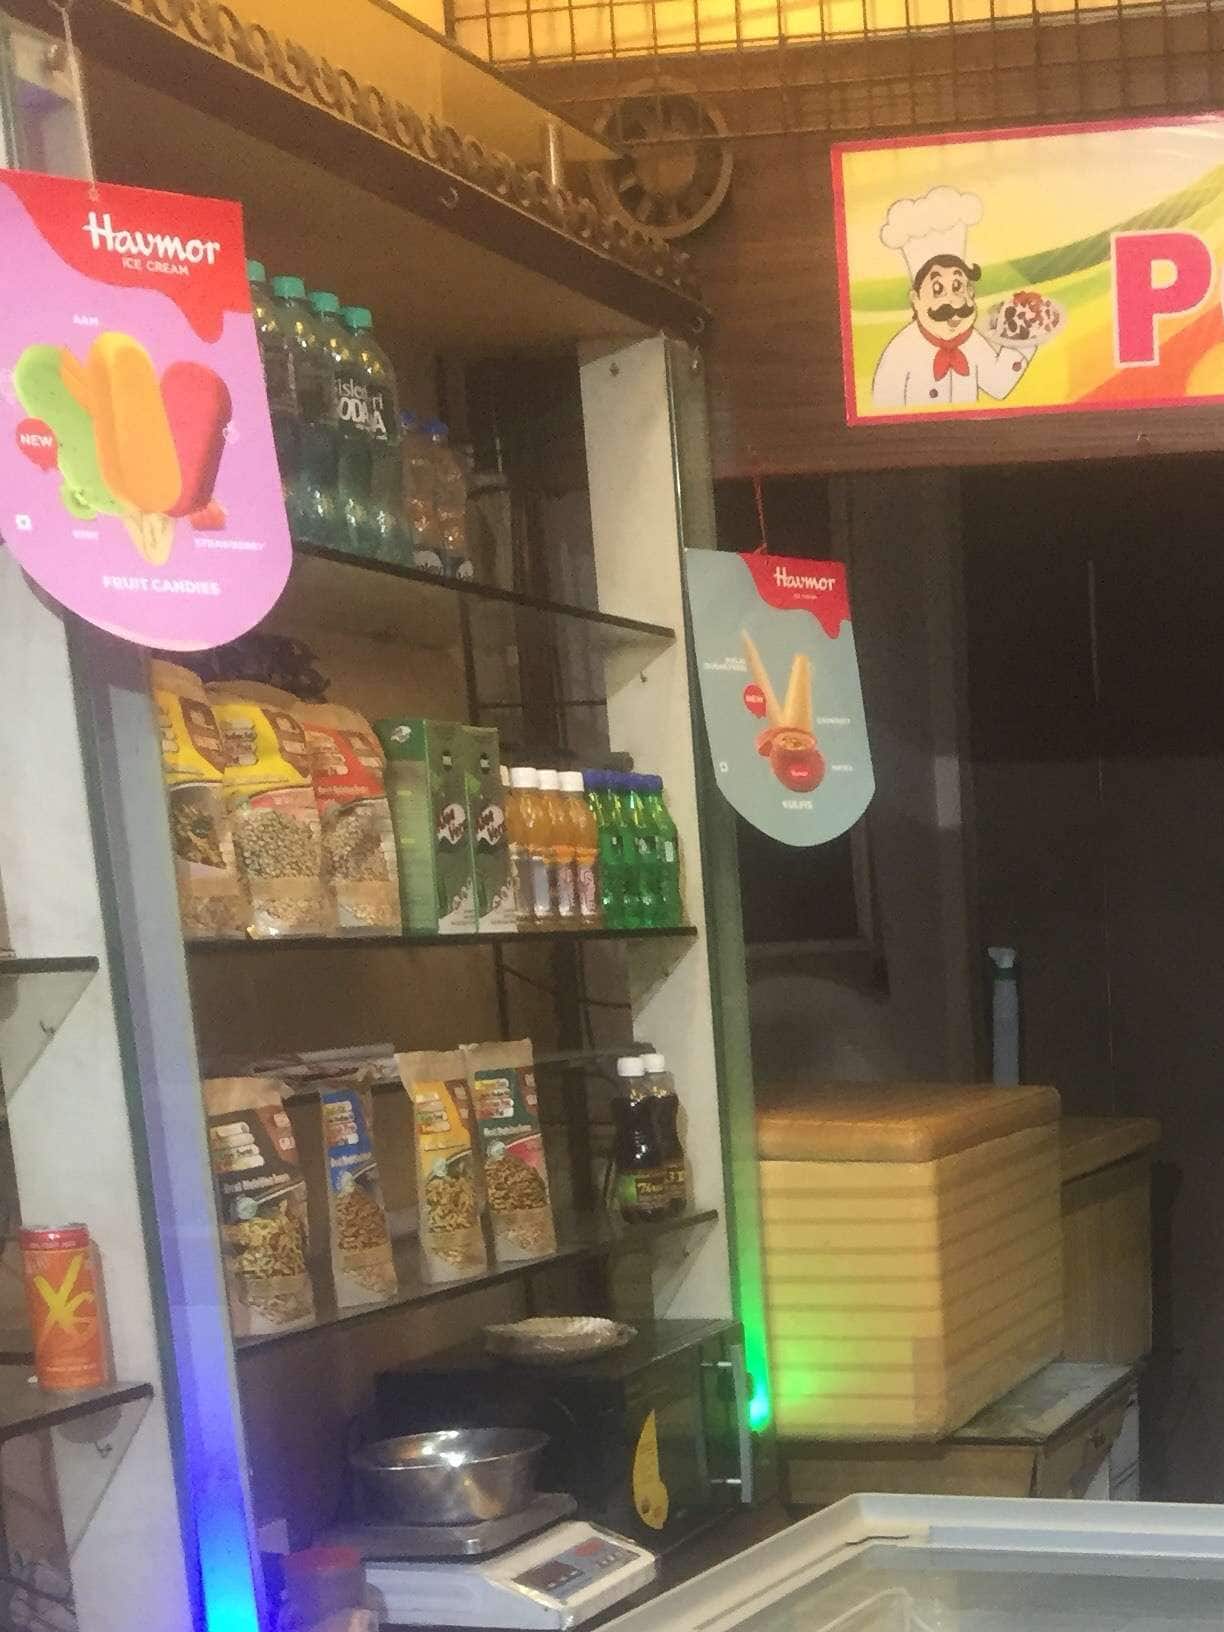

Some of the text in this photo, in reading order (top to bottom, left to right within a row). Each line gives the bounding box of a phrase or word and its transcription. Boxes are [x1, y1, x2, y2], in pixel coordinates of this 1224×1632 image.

[82, 211, 221, 265] Havmor
[122, 257, 191, 276] ICE CREAM
[20, 432, 54, 448] NEW
[102, 575, 222, 597] FRUIT CANDIES
[773, 566, 837, 591] Havmor
